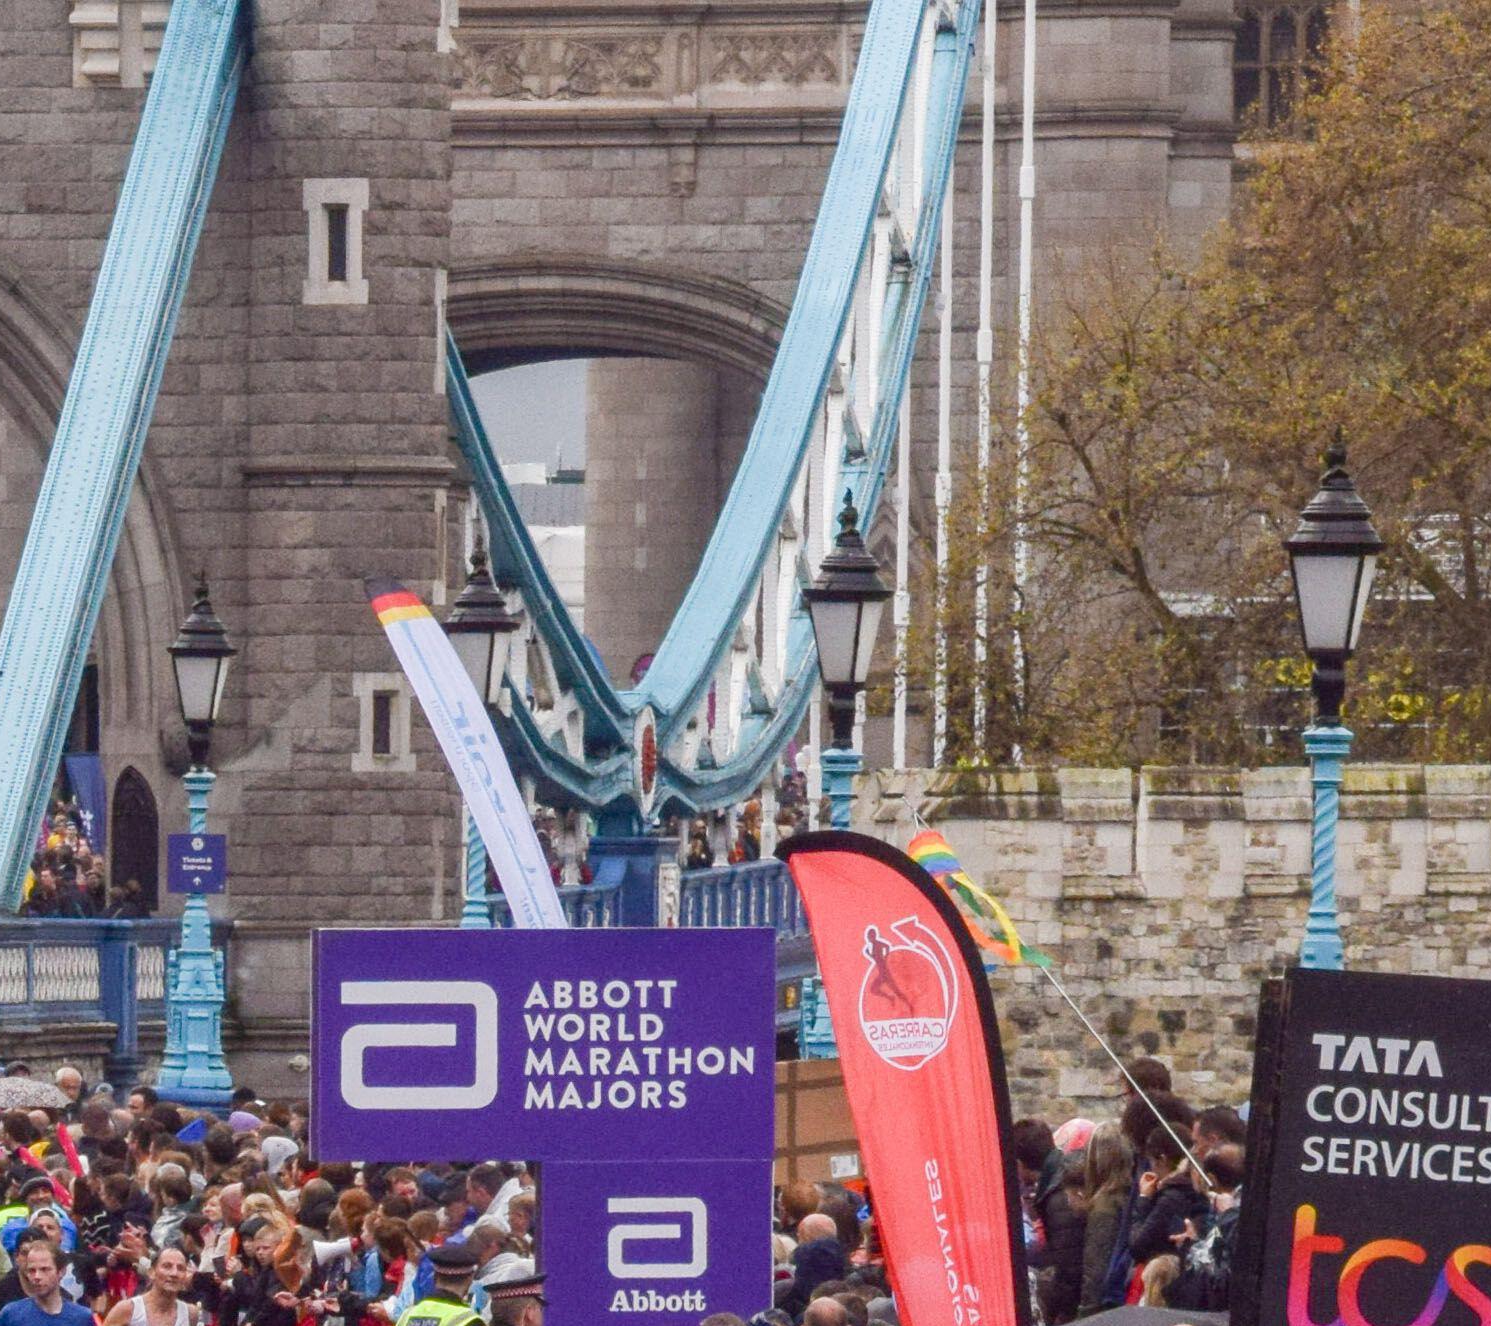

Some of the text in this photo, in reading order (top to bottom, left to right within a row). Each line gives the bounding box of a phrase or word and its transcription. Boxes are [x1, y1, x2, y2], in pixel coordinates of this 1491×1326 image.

[523, 980, 677, 1009] ABBOTT
[523, 1014, 664, 1041] WORLD
[523, 1047, 754, 1076] MARATHON
[1312, 1033, 1444, 1076] TATA
[523, 1080, 687, 1112] MAJORS
[608, 1289, 706, 1313] Abbott
